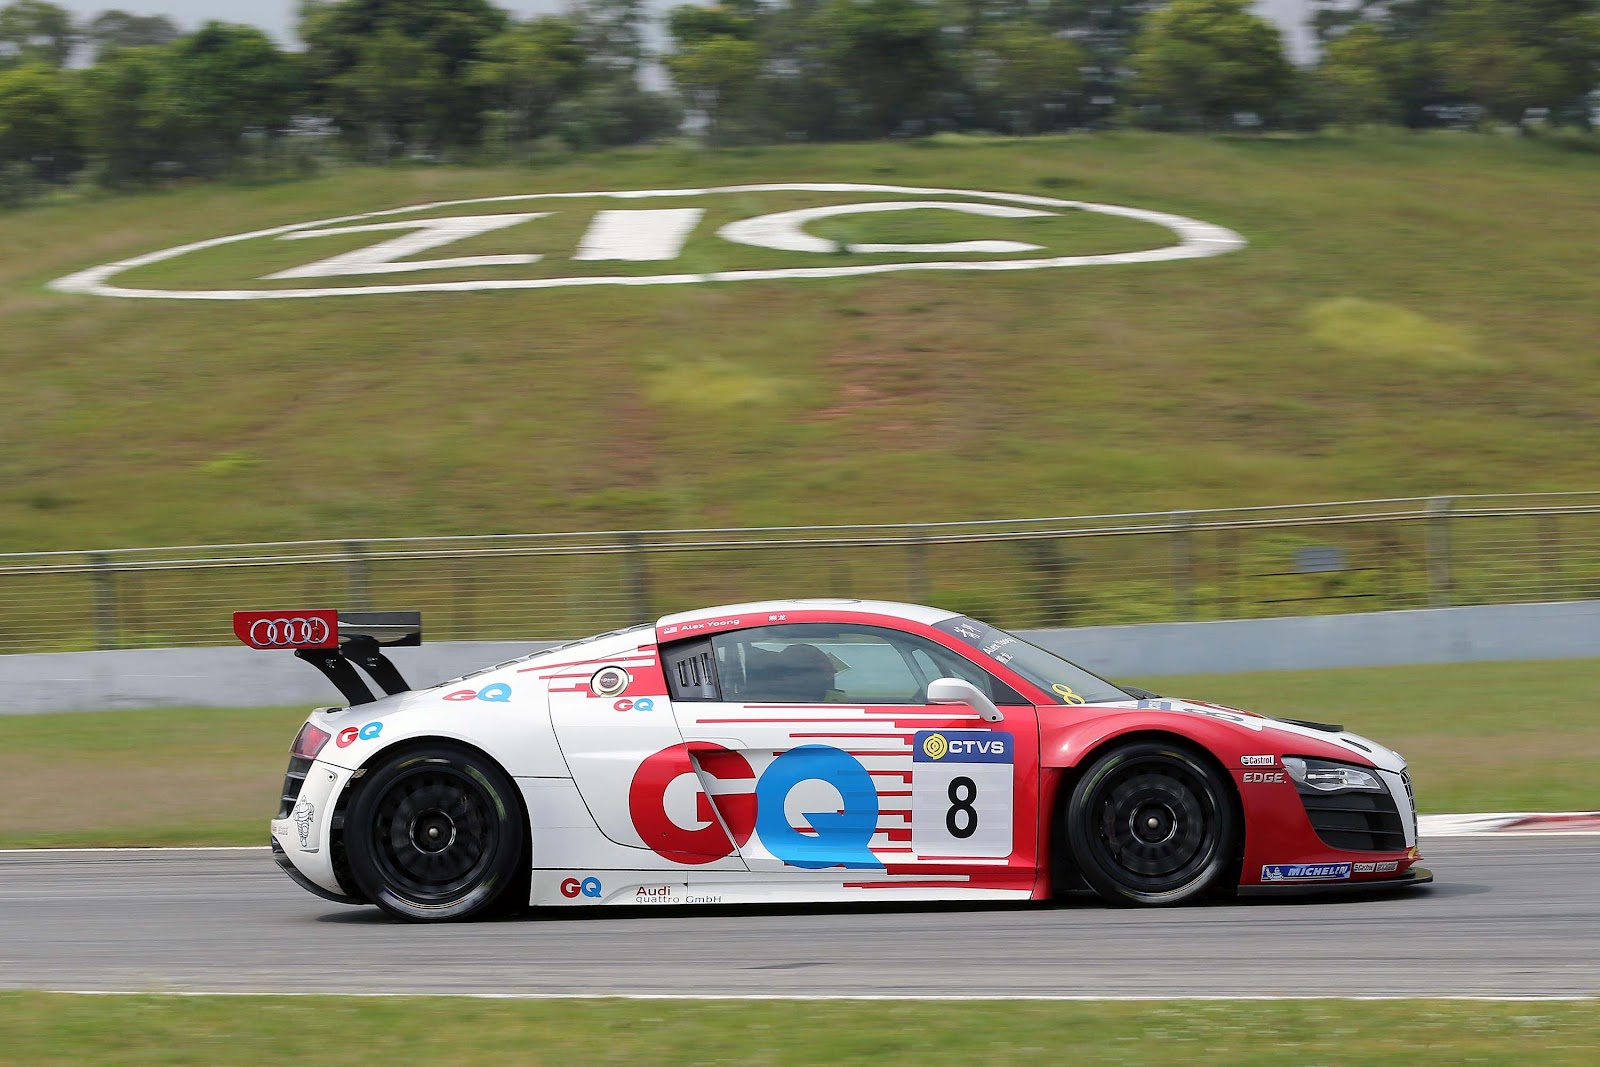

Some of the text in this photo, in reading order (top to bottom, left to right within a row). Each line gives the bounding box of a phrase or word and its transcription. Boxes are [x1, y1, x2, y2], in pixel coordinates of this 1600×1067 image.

[260, 200, 1062, 280] ZIC
[681, 619, 740, 631] Alex Yoong
[444, 682, 512, 703] GQ
[1051, 683, 1086, 705] 8
[613, 697, 654, 712] GQ
[335, 721, 384, 749] GQ
[948, 740, 1004, 754] CTVS
[1249, 756, 1273, 765] Castrol
[1242, 772, 1285, 783] EDGE
[629, 741, 887, 870] GQ
[945, 776, 978, 839] 8
[1287, 865, 1348, 877] MICHELIN
[560, 876, 602, 899] GQ
[635, 886, 671, 896] Audi
[635, 895, 722, 904] quattro GmbH
